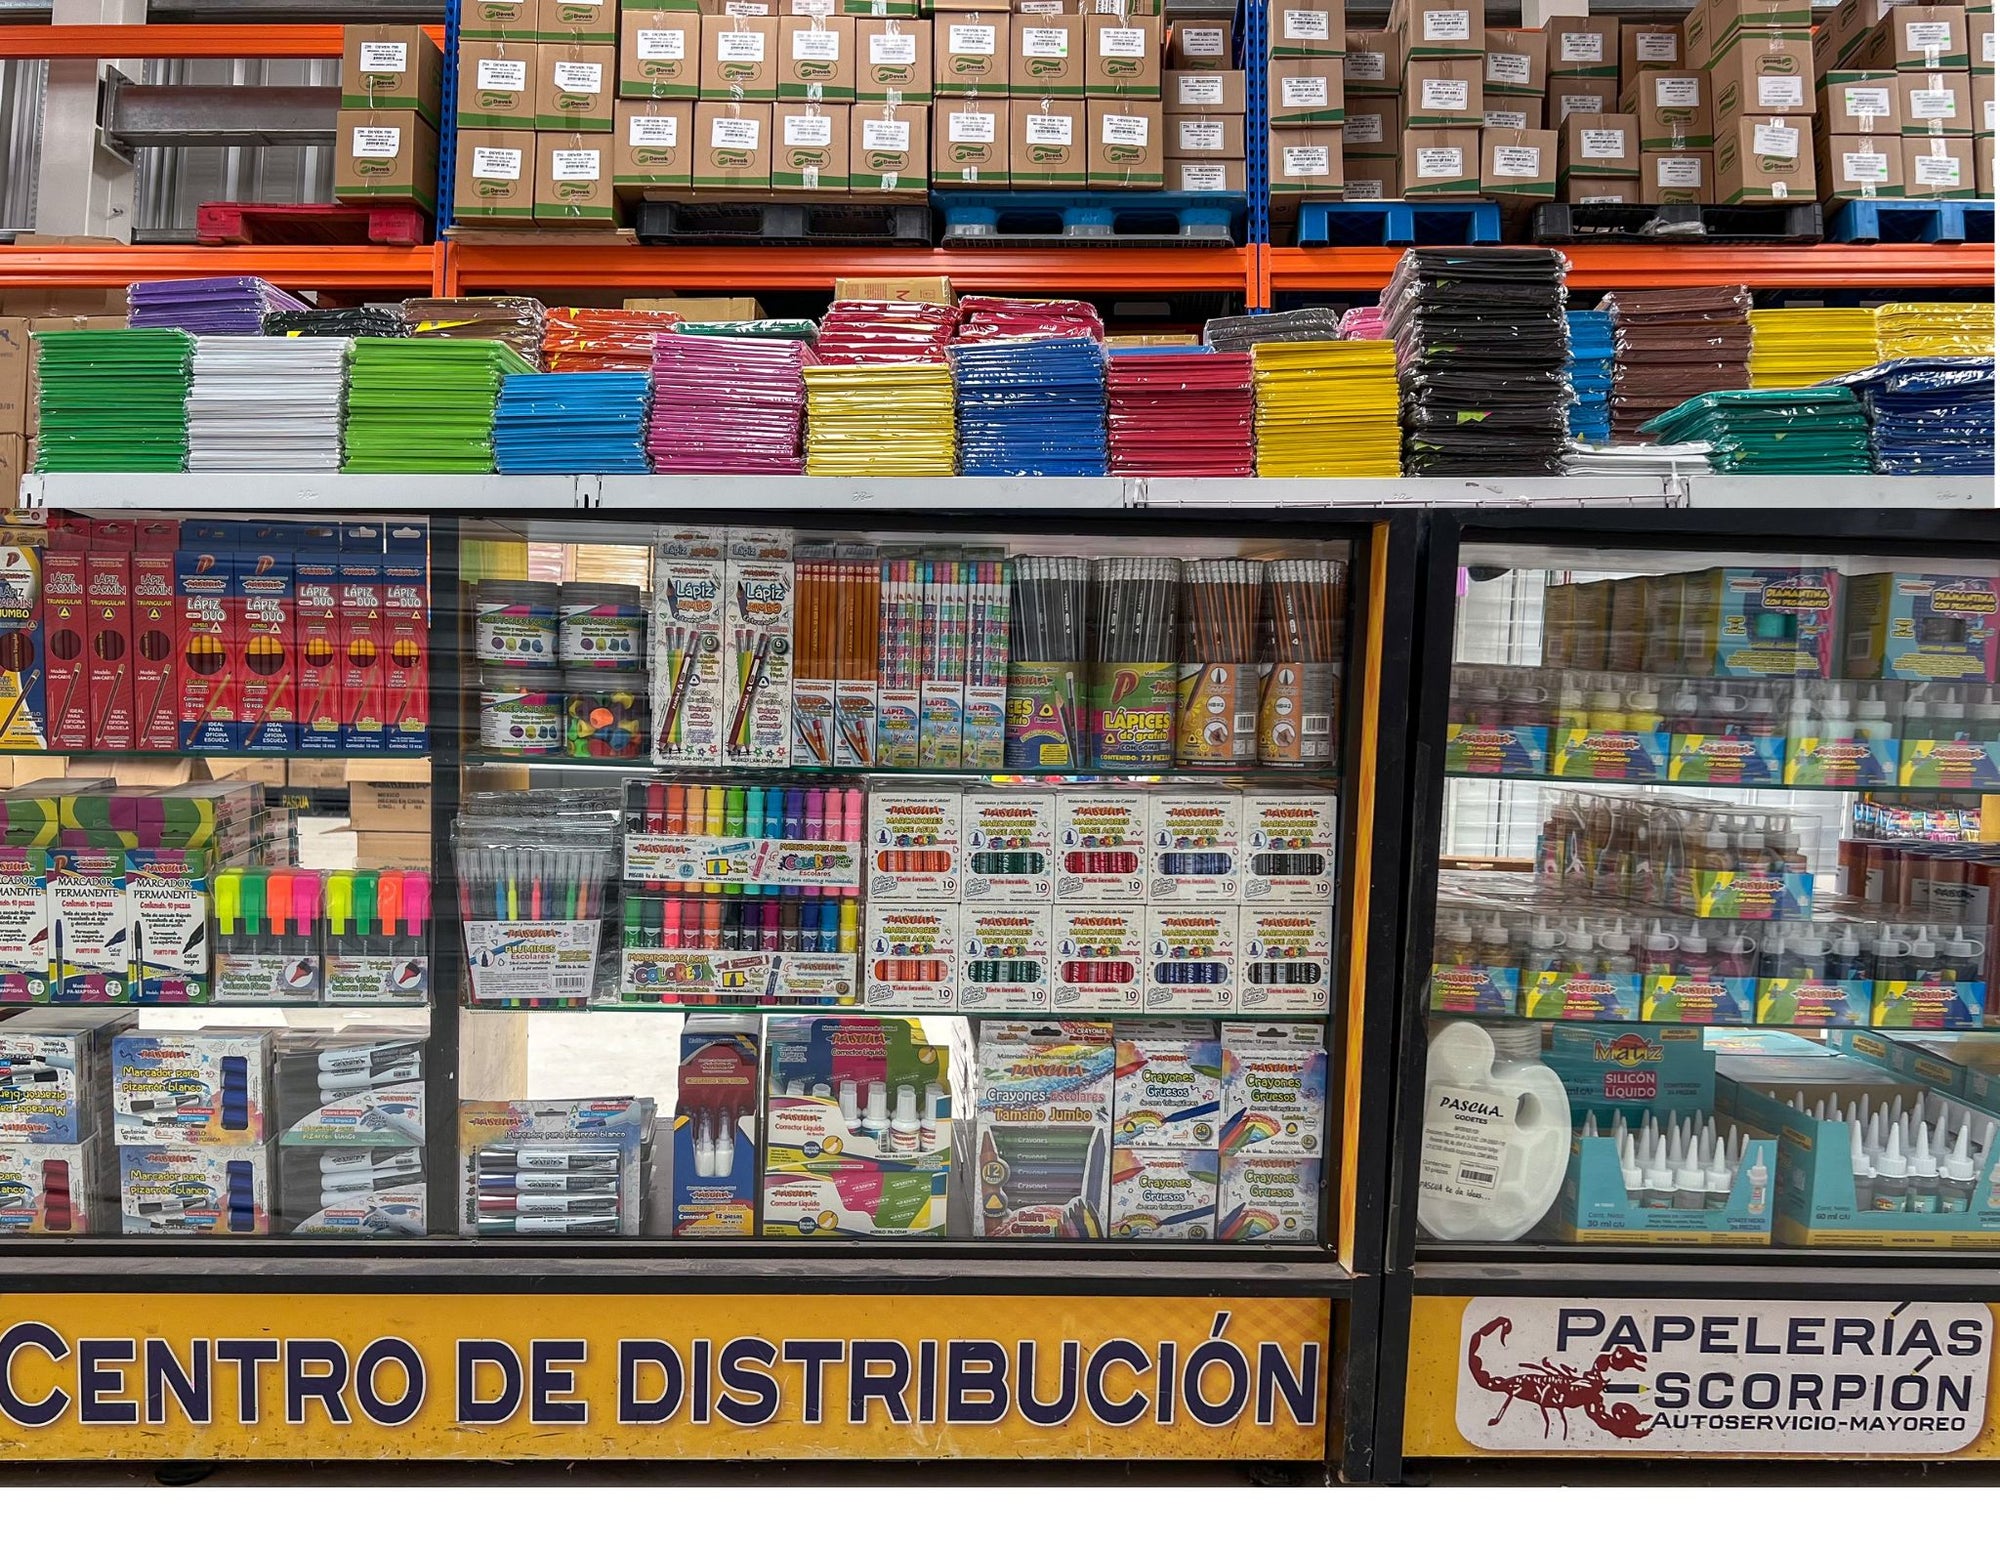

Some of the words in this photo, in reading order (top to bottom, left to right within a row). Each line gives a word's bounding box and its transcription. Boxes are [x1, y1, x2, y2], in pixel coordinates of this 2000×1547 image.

[663, 544, 688, 556] Lápiz
[675, 580, 716, 599] Lápiz
[745, 581, 785, 602] Lápiz
[1766, 587, 1828, 599] DIAMANTINA
[1935, 591, 1996, 602] DIAMANTINA
[1782, 599, 1828, 607] PEGAMENTO
[1950, 603, 1996, 611] PEGAMENTO
[1103, 706, 1170, 731] LÁPICES
[1119, 731, 1135, 741] de
[1136, 730, 1169, 743] grafito
[282, 794, 310, 809] PASCUA
[1166, 819, 1223, 827] MARCADORES
[58, 877, 114, 887] MARCADOR
[137, 878, 192, 888] MARCADOR
[55, 888, 119, 898] PERMANENTE
[134, 889, 197, 899] PERMANENTE
[883, 926, 940, 934] MARCADORES
[505, 945, 557, 953] PLUMINES
[628, 953, 670, 962] MARCADOR
[670, 954, 687, 962] BASE
[688, 955, 709, 963] AGUA
[635, 962, 704, 984] COLORES
[938, 989, 950, 997] 10
[1032, 991, 1043, 999] 10
[1217, 992, 1229, 1000] 10
[1313, 992, 1324, 1000] 10
[863, 1048, 887, 1057] Líquido
[1593, 1037, 1664, 1063] Matiz
[122, 1066, 173, 1078] Marcador
[174, 1068, 200, 1078] para
[1011, 1064, 1083, 1077] PASCUA
[1141, 1068, 1195, 1084] Crayones
[1245, 1073, 1301, 1089] Crayones
[1605, 1070, 1655, 1084] SILICÓN
[167, 1081, 203, 1092] blanco
[1146, 1085, 1189, 1097] Gruesos
[1605, 1085, 1656, 1098] LÍQUIDO
[986, 1087, 1047, 1103] Crayones
[1250, 1089, 1296, 1102] Gruesos
[1440, 1096, 1500, 1117] PASCUA
[994, 1107, 1046, 1120] Tamaño
[1048, 1106, 1092, 1121] Jumbo
[1454, 1114, 1488, 1125] GODETES
[803, 1122, 825, 1131] Líquido
[505, 1131, 544, 1139] Marcador
[545, 1132, 564, 1140] para
[129, 1171, 180, 1181] Marcador
[182, 1173, 206, 1182] para
[986, 1164, 1000, 1177] 12
[1244, 1169, 1300, 1184] Crayones
[1139, 1175, 1192, 1189] Crayones
[1142, 1190, 1185, 1202] Gruesos
[1250, 1185, 1294, 1198] Gruesos
[798, 1200, 820, 1208] Líquido
[1827, 1212, 1838, 1220] ml
[1587, 1220, 1599, 1228] 30
[1600, 1219, 1613, 1228] ml
[1556, 1300, 1983, 1356] PAPELERÍAS
[0, 1320, 427, 1427] CENTRO
[455, 1338, 589, 1424] DE
[617, 1311, 1322, 1428] DISTRIBUCIÓN
[1650, 1411, 1966, 1432] AUTOSERVICIO-MAYOREO
